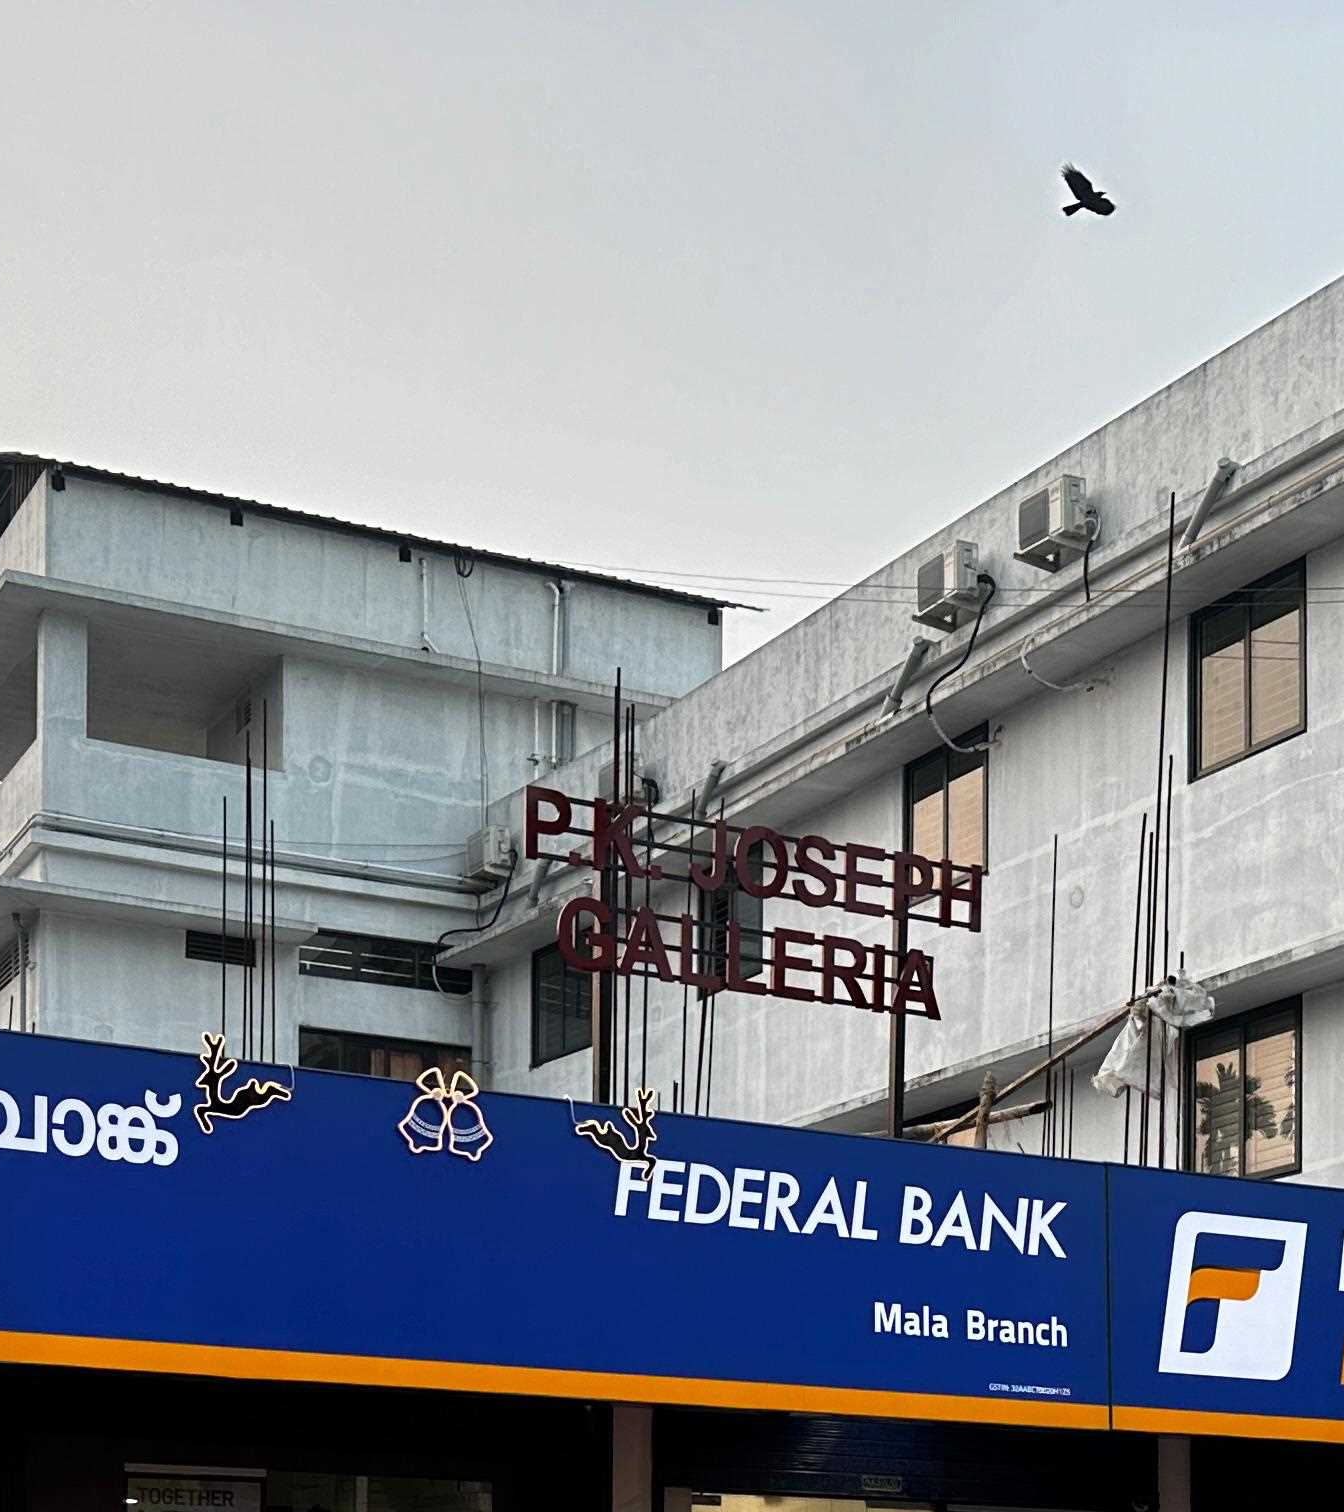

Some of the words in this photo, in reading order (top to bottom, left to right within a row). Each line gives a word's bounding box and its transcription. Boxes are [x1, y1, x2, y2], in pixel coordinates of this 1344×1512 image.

[525, 786, 662, 880] P.K.
[693, 820, 981, 933] JOSEPH
[557, 897, 942, 1020] GALLERIA
[614, 1161, 878, 1240] FEDERAL
[899, 1186, 1067, 1258] BANK
[874, 1302, 949, 1339] Mala
[967, 1310, 1068, 1347] Branch
[137, 1487, 234, 1506] TOGETHER
